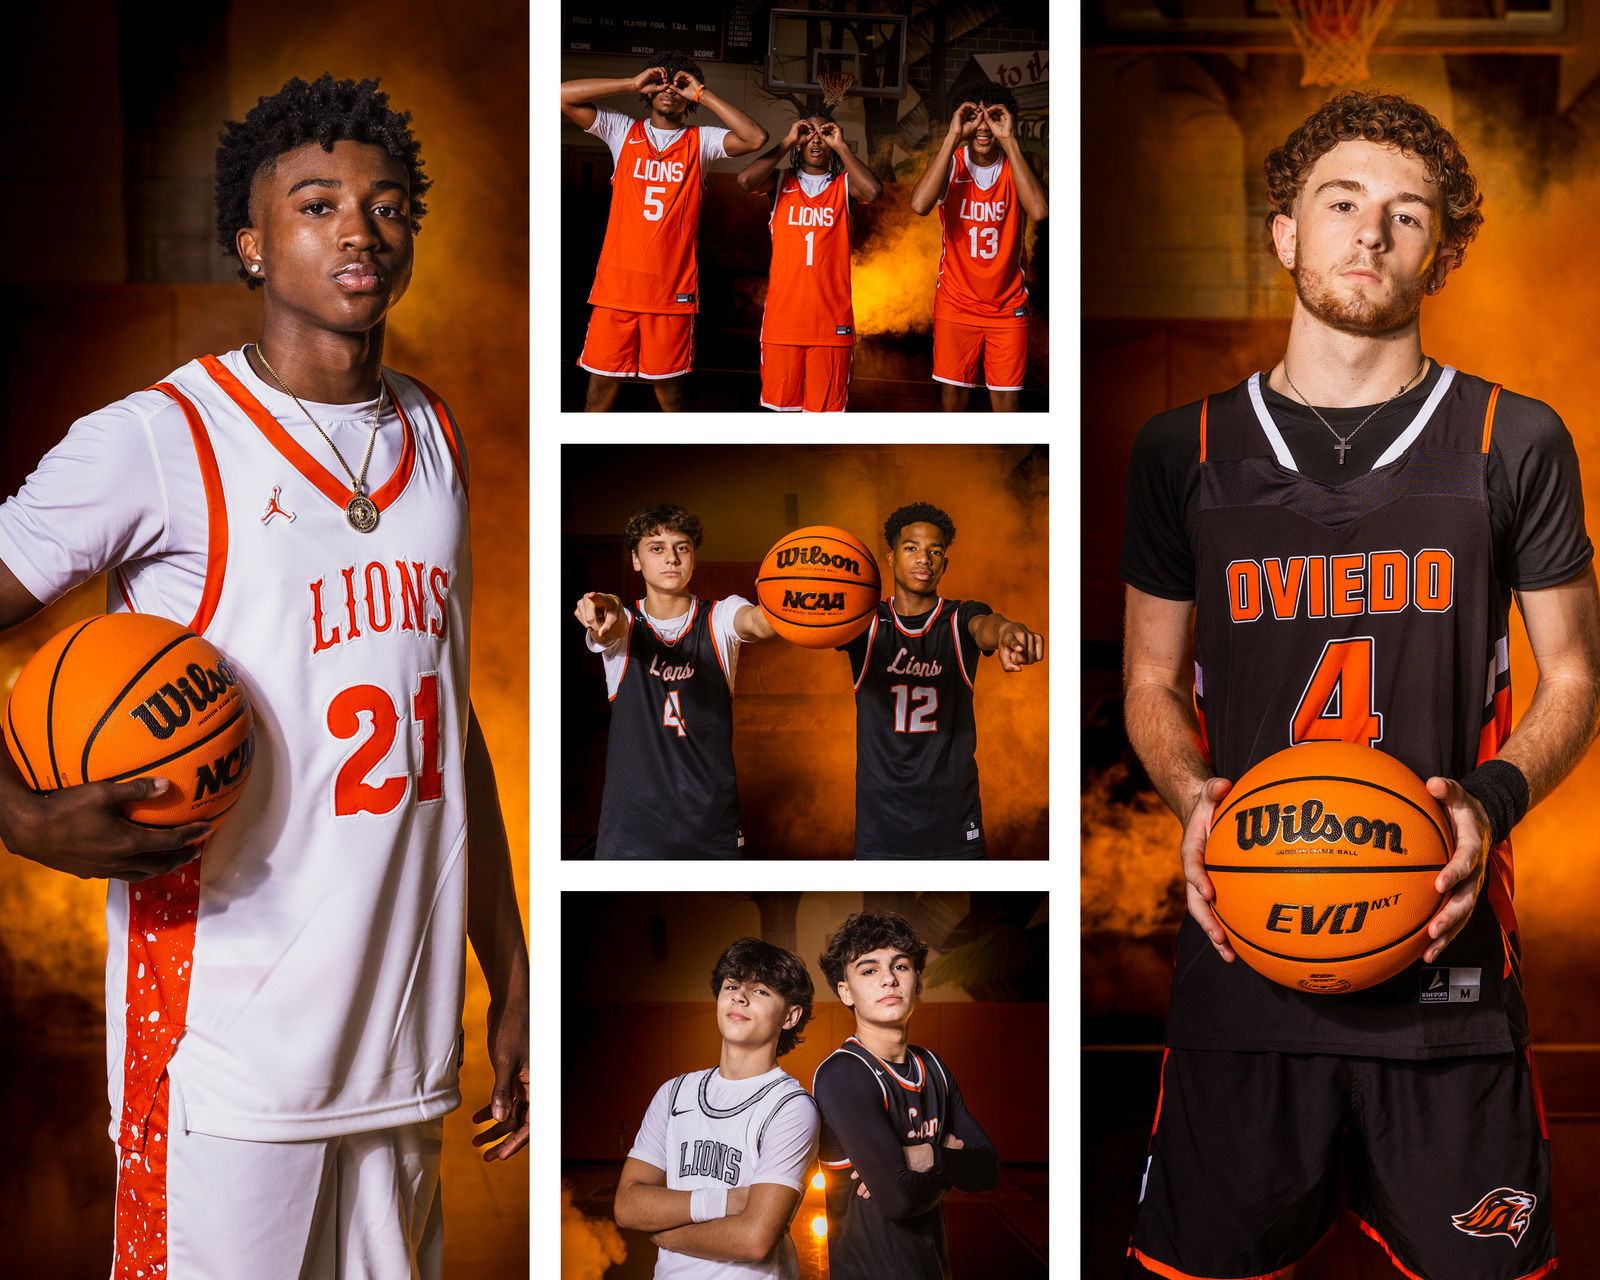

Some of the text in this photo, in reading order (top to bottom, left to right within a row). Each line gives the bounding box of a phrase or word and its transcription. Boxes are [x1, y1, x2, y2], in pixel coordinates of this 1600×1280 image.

[650, 21, 666, 30] FOUL
[695, 24, 716, 32] FOULS
[570, 42, 714, 58] SCORE MATCH SCORE
[997, 64, 1022, 87] to
[633, 158, 684, 183] LIONS
[643, 186, 666, 221] 5
[788, 205, 834, 227] LIONS
[960, 198, 1005, 222] LIONS
[804, 231, 815, 266] 1
[968, 226, 999, 260] 13
[776, 545, 861, 576] Wilson
[782, 589, 846, 611] NCAA
[1226, 548, 1455, 624] OVIEDO
[308, 558, 450, 657] LIONS
[886, 647, 942, 677] Lions
[129, 657, 239, 739] Wilso
[890, 684, 939, 734] 12
[1290, 636, 1383, 750] 4
[663, 690, 688, 737] 4
[324, 670, 444, 818] 21
[1234, 799, 1405, 855] Wilson
[1337, 849, 1359, 857] BALL
[1266, 893, 1402, 936] EVO NXT
[1460, 988, 1471, 999] M
[679, 1140, 743, 1186] LIONS
